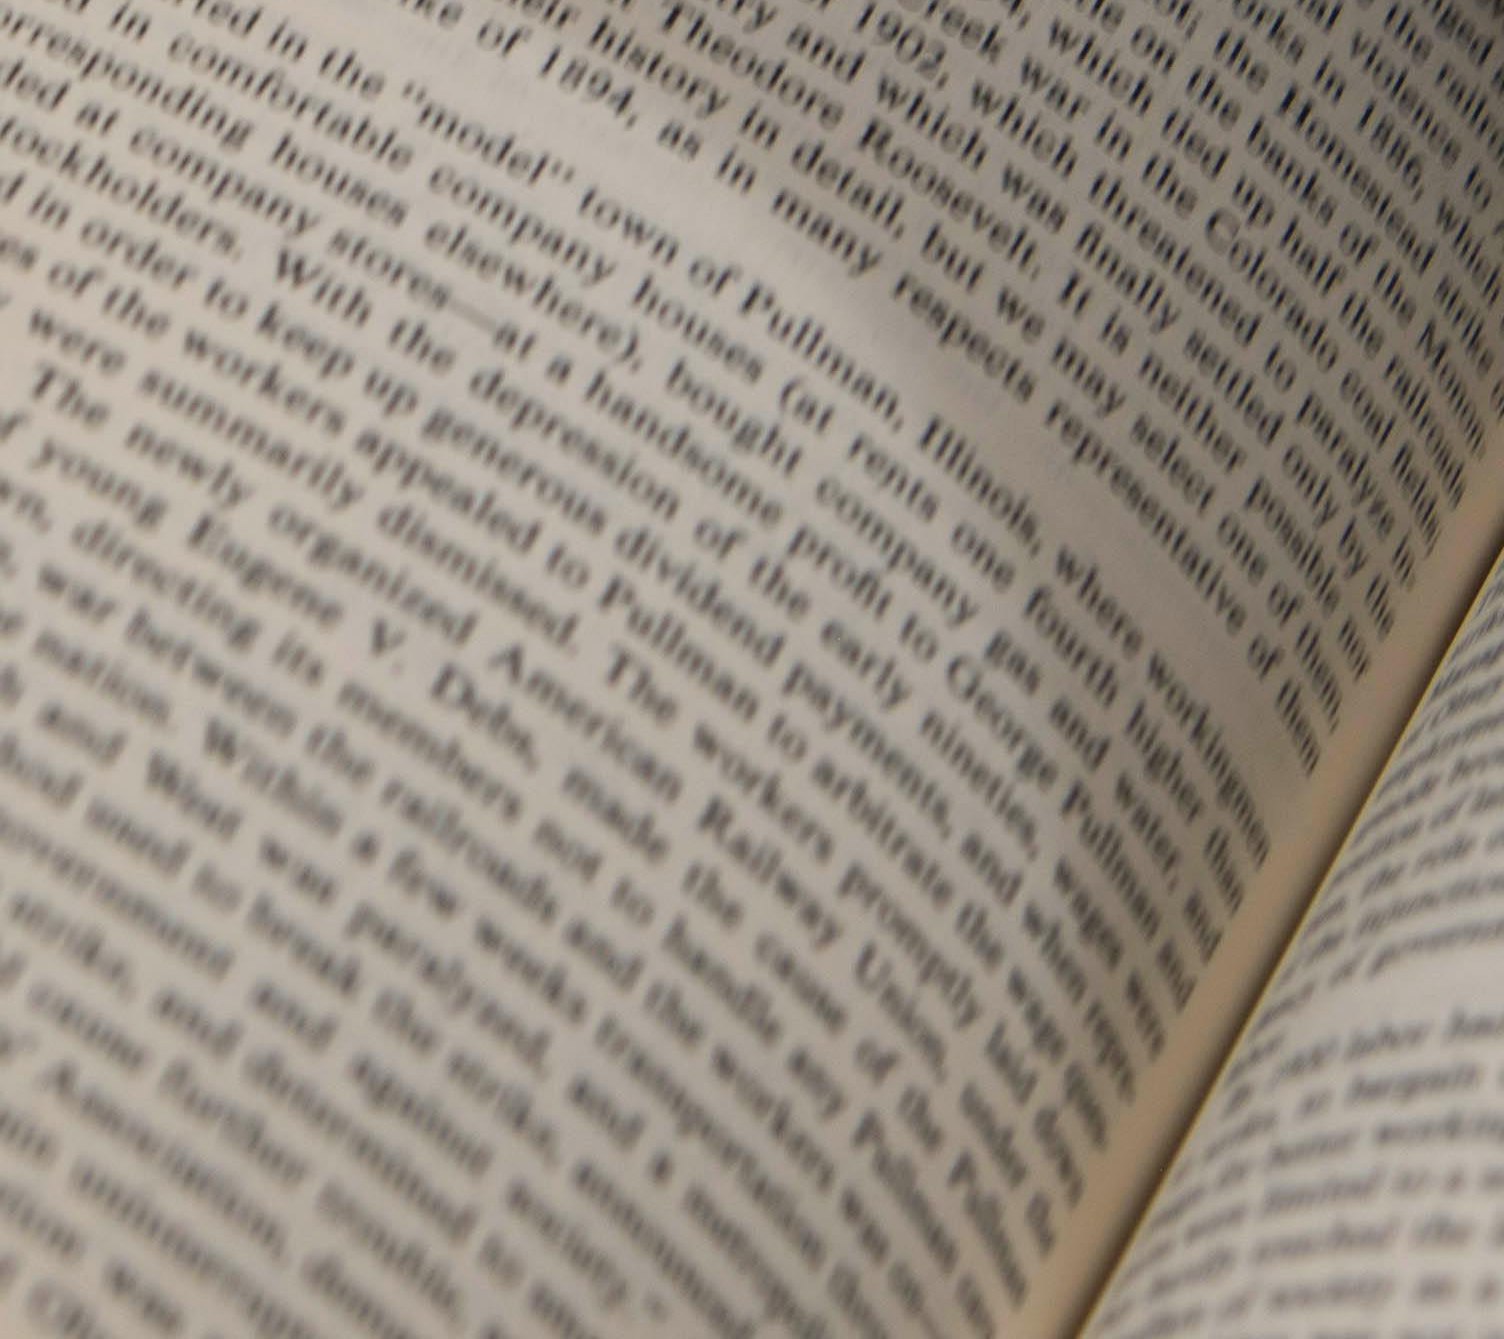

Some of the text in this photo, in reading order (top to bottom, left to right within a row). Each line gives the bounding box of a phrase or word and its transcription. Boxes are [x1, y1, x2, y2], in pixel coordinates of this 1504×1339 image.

[166, 35, 415, 168] comfortable
[427, 166, 617, 287] company
[265, 19, 310, 64] in
[317, 46, 387, 99] the
[576, 185, 681, 268] town
[475, 20, 534, 60] of
[655, 119, 704, 161] as
[714, 146, 759, 196] in
[769, 186, 885, 278] many
[585, 12, 732, 120] history
[737, 100, 783, 152] in
